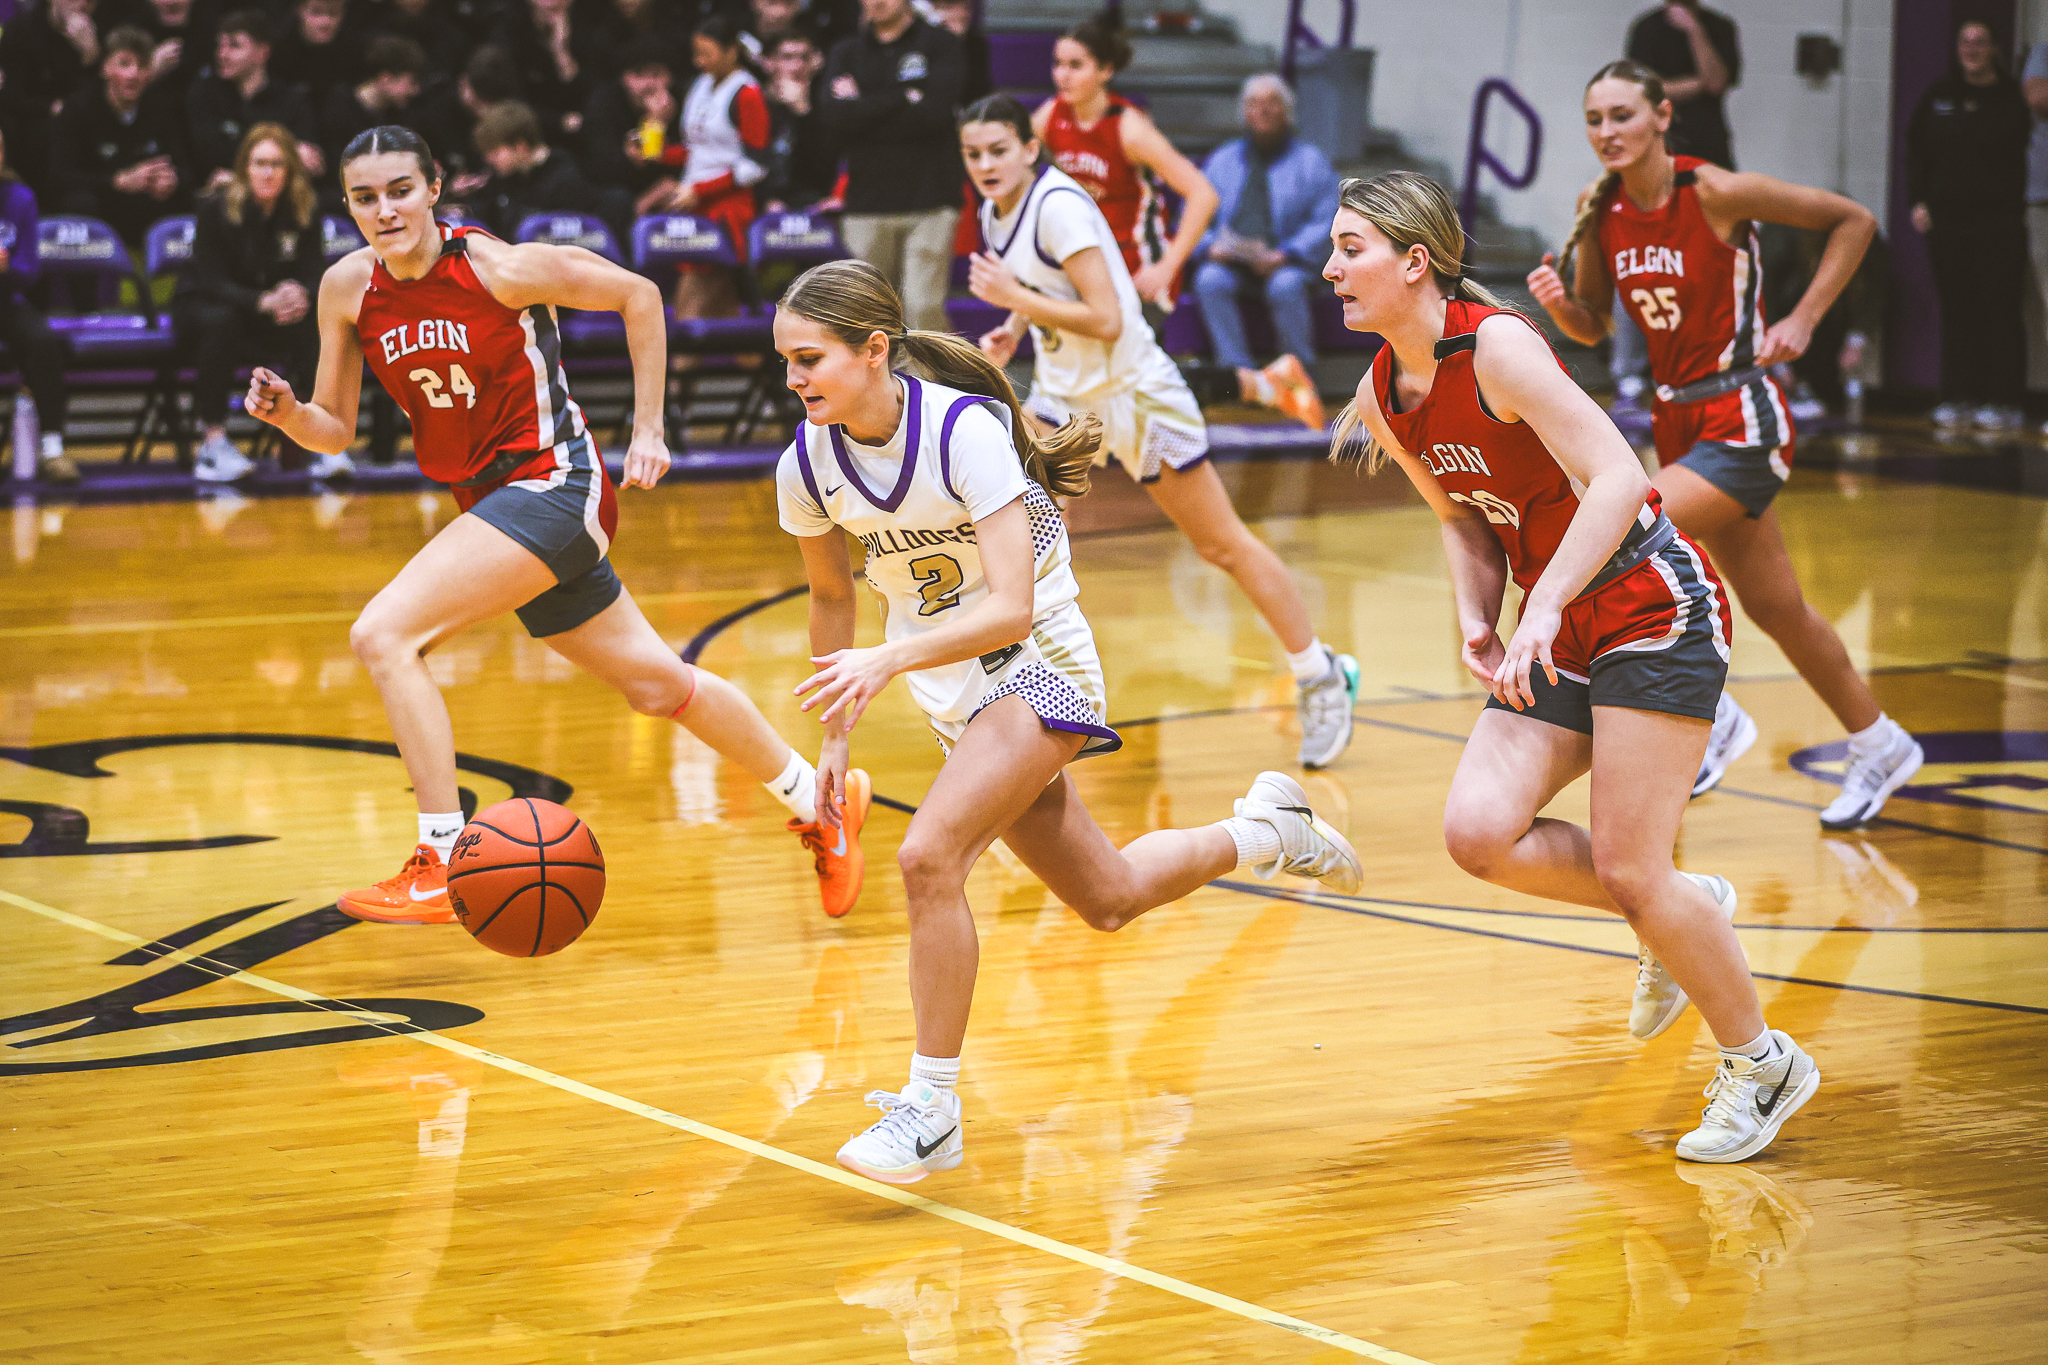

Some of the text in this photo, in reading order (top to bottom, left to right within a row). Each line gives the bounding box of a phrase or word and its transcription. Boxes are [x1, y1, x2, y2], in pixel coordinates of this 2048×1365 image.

[1615, 245, 1684, 280] ELGIN
[1630, 286, 1682, 332] 25
[379, 319, 471, 365] ELGIN
[408, 363, 476, 409] 24
[1421, 443, 1493, 477] LGIN
[1447, 489, 1520, 531] 20
[908, 553, 964, 617] 2
